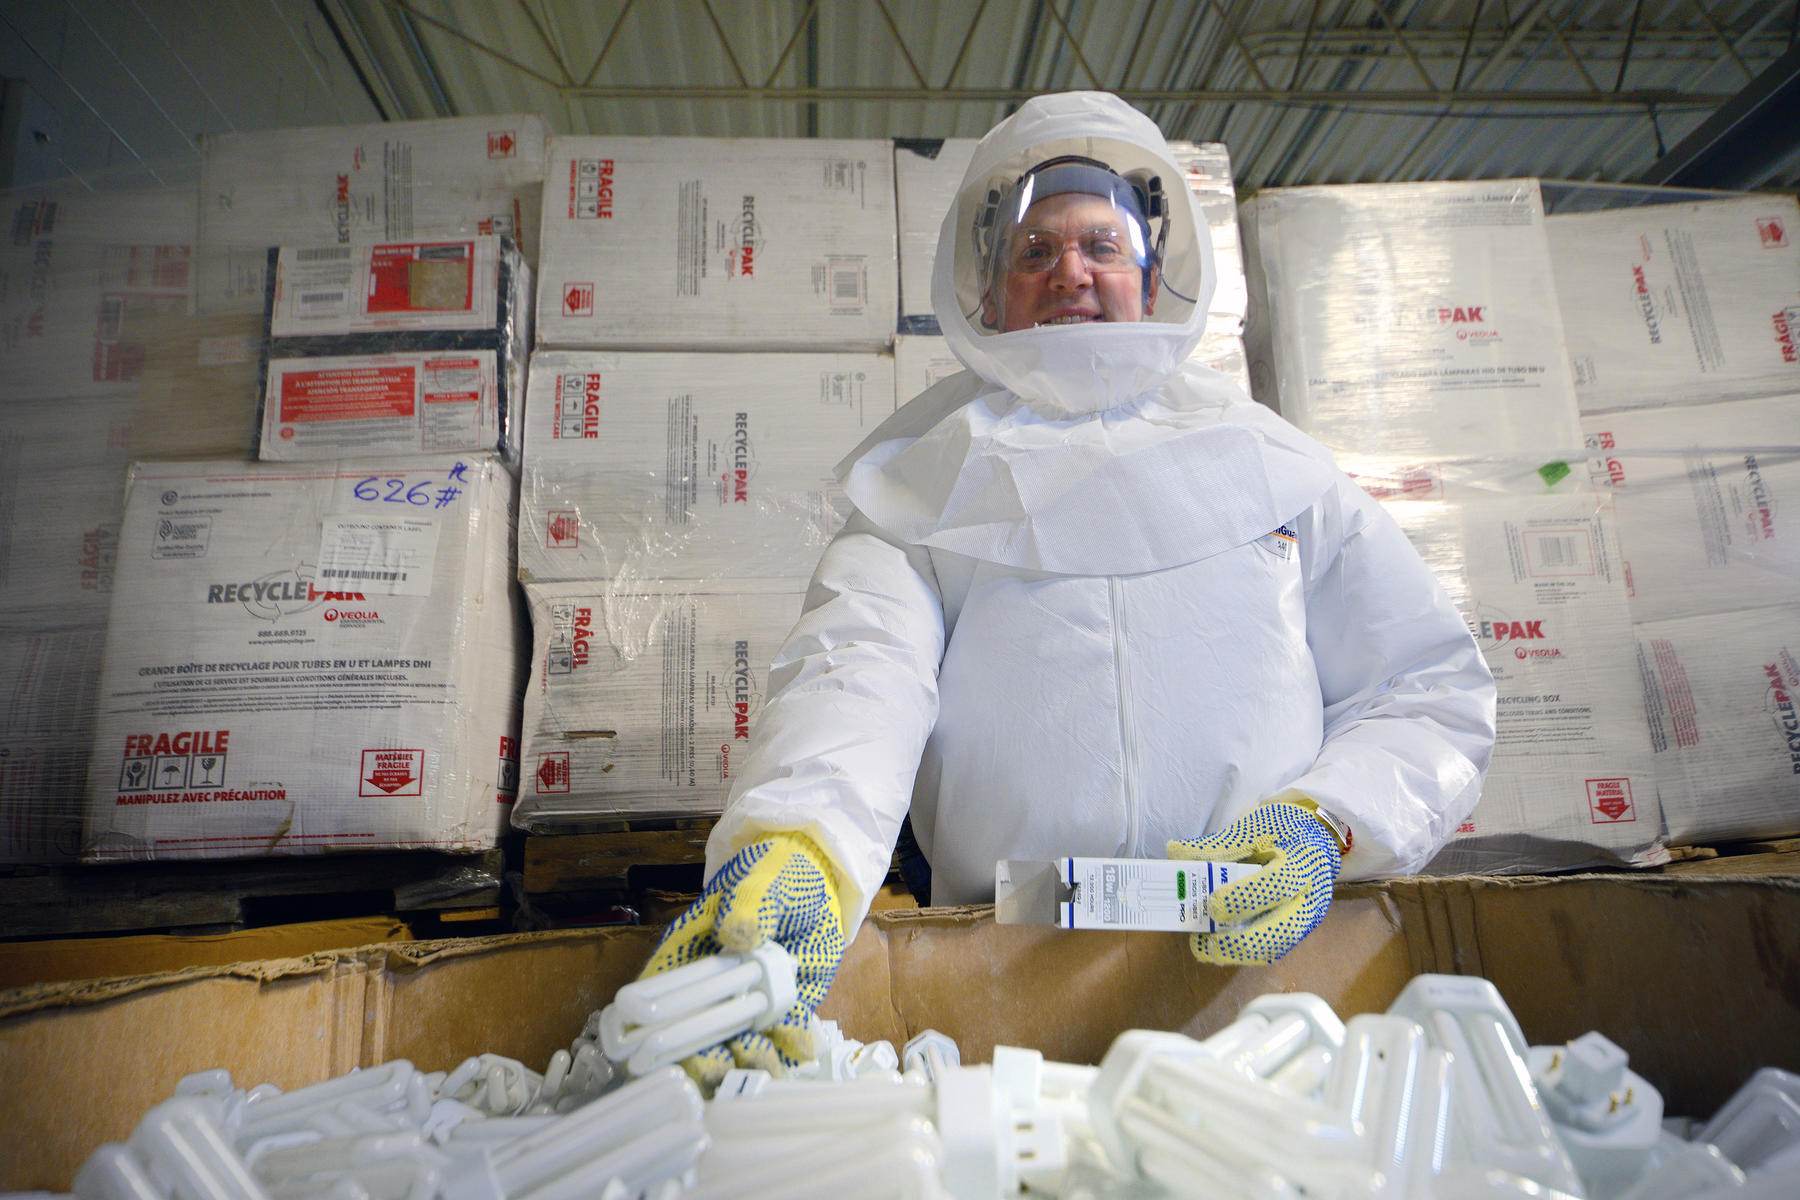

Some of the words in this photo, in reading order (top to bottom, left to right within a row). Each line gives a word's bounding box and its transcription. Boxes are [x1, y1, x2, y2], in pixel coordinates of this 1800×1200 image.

[337, 173, 350, 243] ECYCLEPAK
[598, 159, 614, 219] FRAGILE
[741, 194, 755, 276] RECYCLEPAK
[1632, 265, 1662, 344] RECYCLEPAK
[1772, 310, 1798, 363] FRÁGIL
[584, 373, 600, 439] FRAGILE
[734, 411, 748, 503] RECYCLEPAK
[1744, 455, 1775, 540] RECYCLEPAK
[340, 610, 379, 620] VEOLIA
[573, 608, 596, 669] FRÁGIL
[138, 665, 175, 676] GRANDE
[177, 661, 204, 674] BOÎTE
[205, 663, 218, 673] DE
[218, 661, 271, 673] RECYCLAGE
[272, 660, 300, 669] POUR
[301, 659, 331, 669] TUBES
[333, 659, 347, 668] EN
[348, 659, 356, 668] U
[359, 659, 369, 668] ET
[371, 659, 410, 668] LAMPES
[296, 674, 336, 682] CONDITIONS
[337, 673, 374, 681] GÉNÉRALES
[1529, 648, 1561, 657] VEOLIA
[734, 640, 749, 740] RECYCLEPAK
[124, 730, 230, 757] FRAGILE
[375, 752, 413, 761] MATÉRIEL
[116, 793, 181, 806] MANIPULEZ
[182, 791, 213, 802] AVEC
[213, 788, 287, 802] PRÉCAUTION
